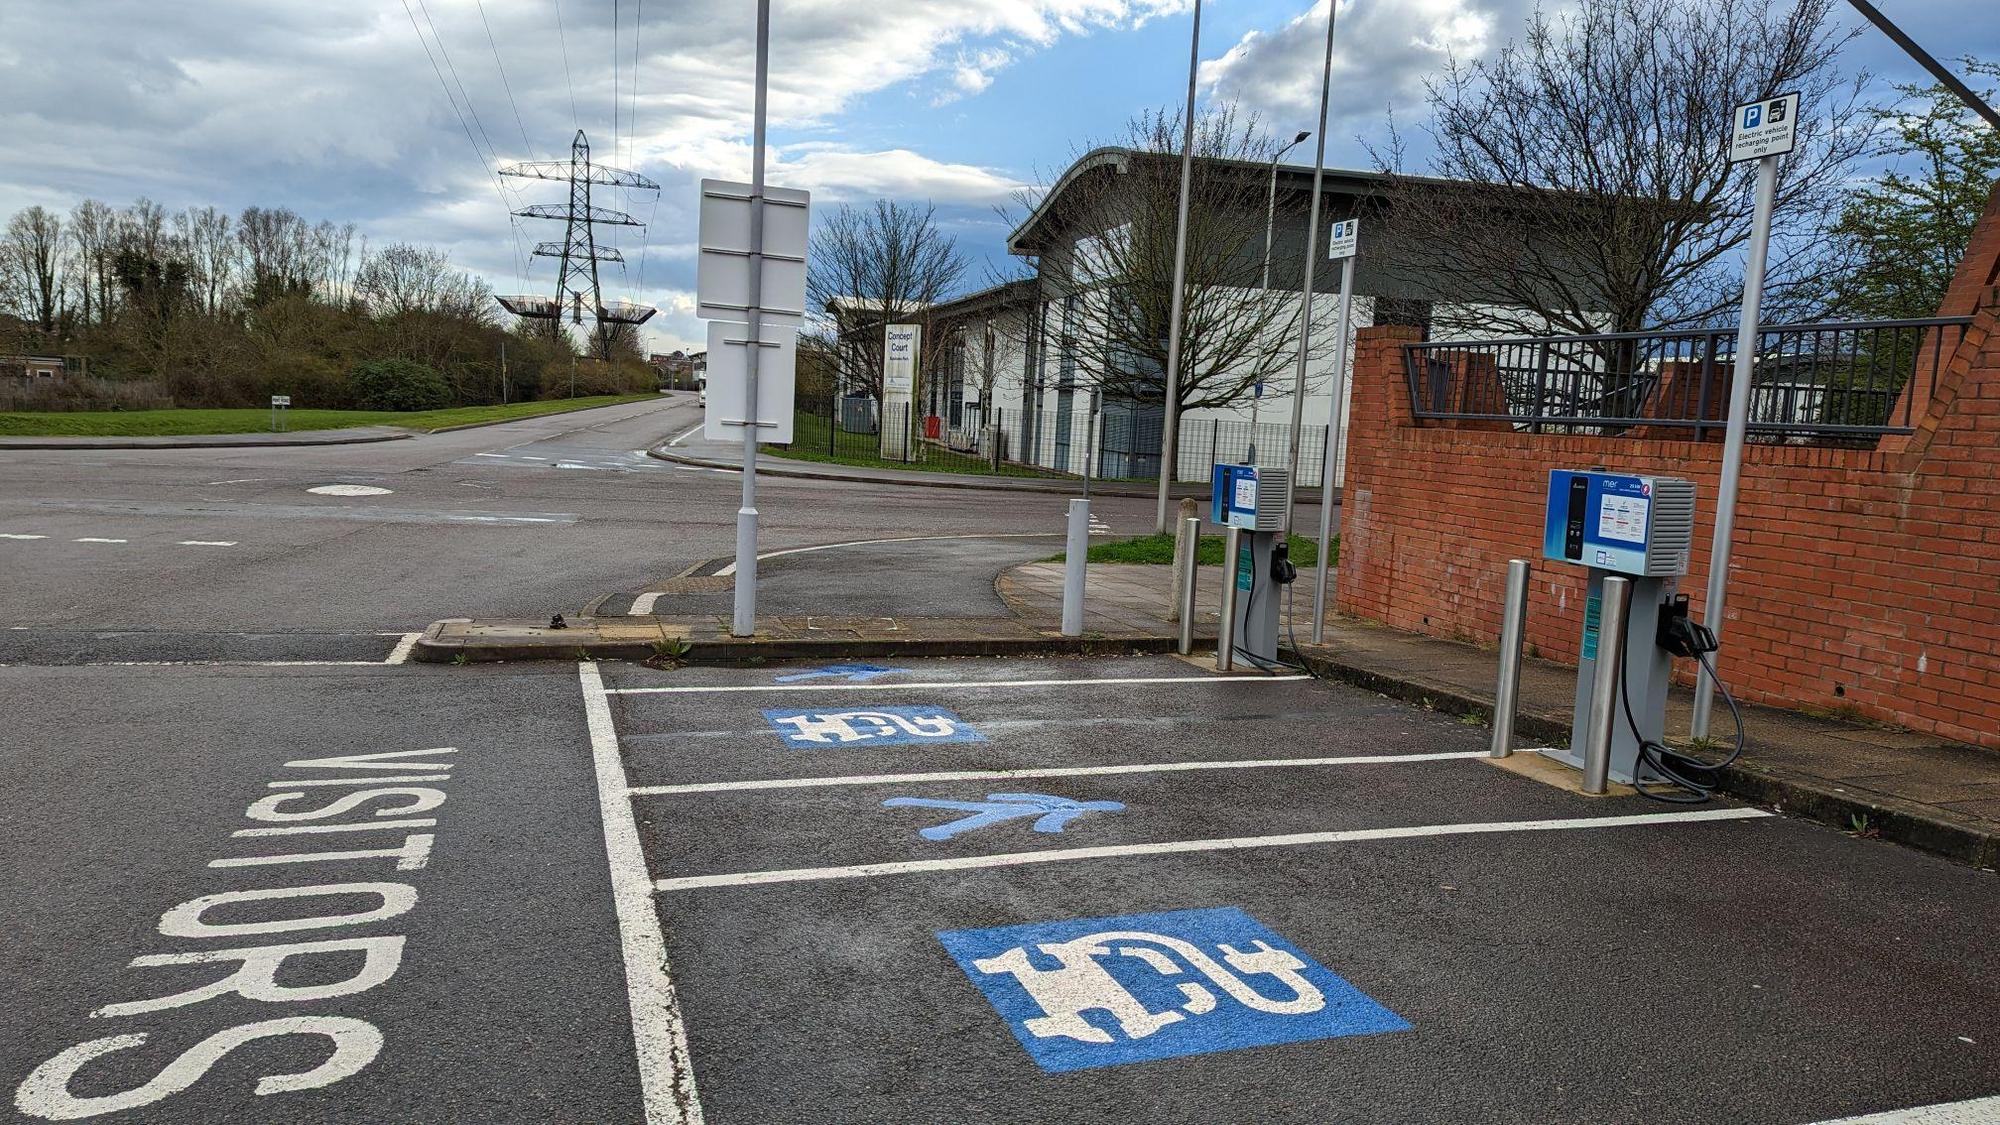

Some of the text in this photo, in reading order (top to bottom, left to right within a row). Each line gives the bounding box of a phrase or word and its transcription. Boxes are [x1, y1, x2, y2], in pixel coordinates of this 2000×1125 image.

[1747, 108, 1758, 126] P
[1738, 125, 1788, 140] Electric vehicle
[1736, 133, 1788, 148] recharging point
[888, 331, 912, 341] Concept
[891, 343, 908, 351] Court
[1602, 480, 1618, 488] mer
[14, 747, 458, 1121] VISITORS
